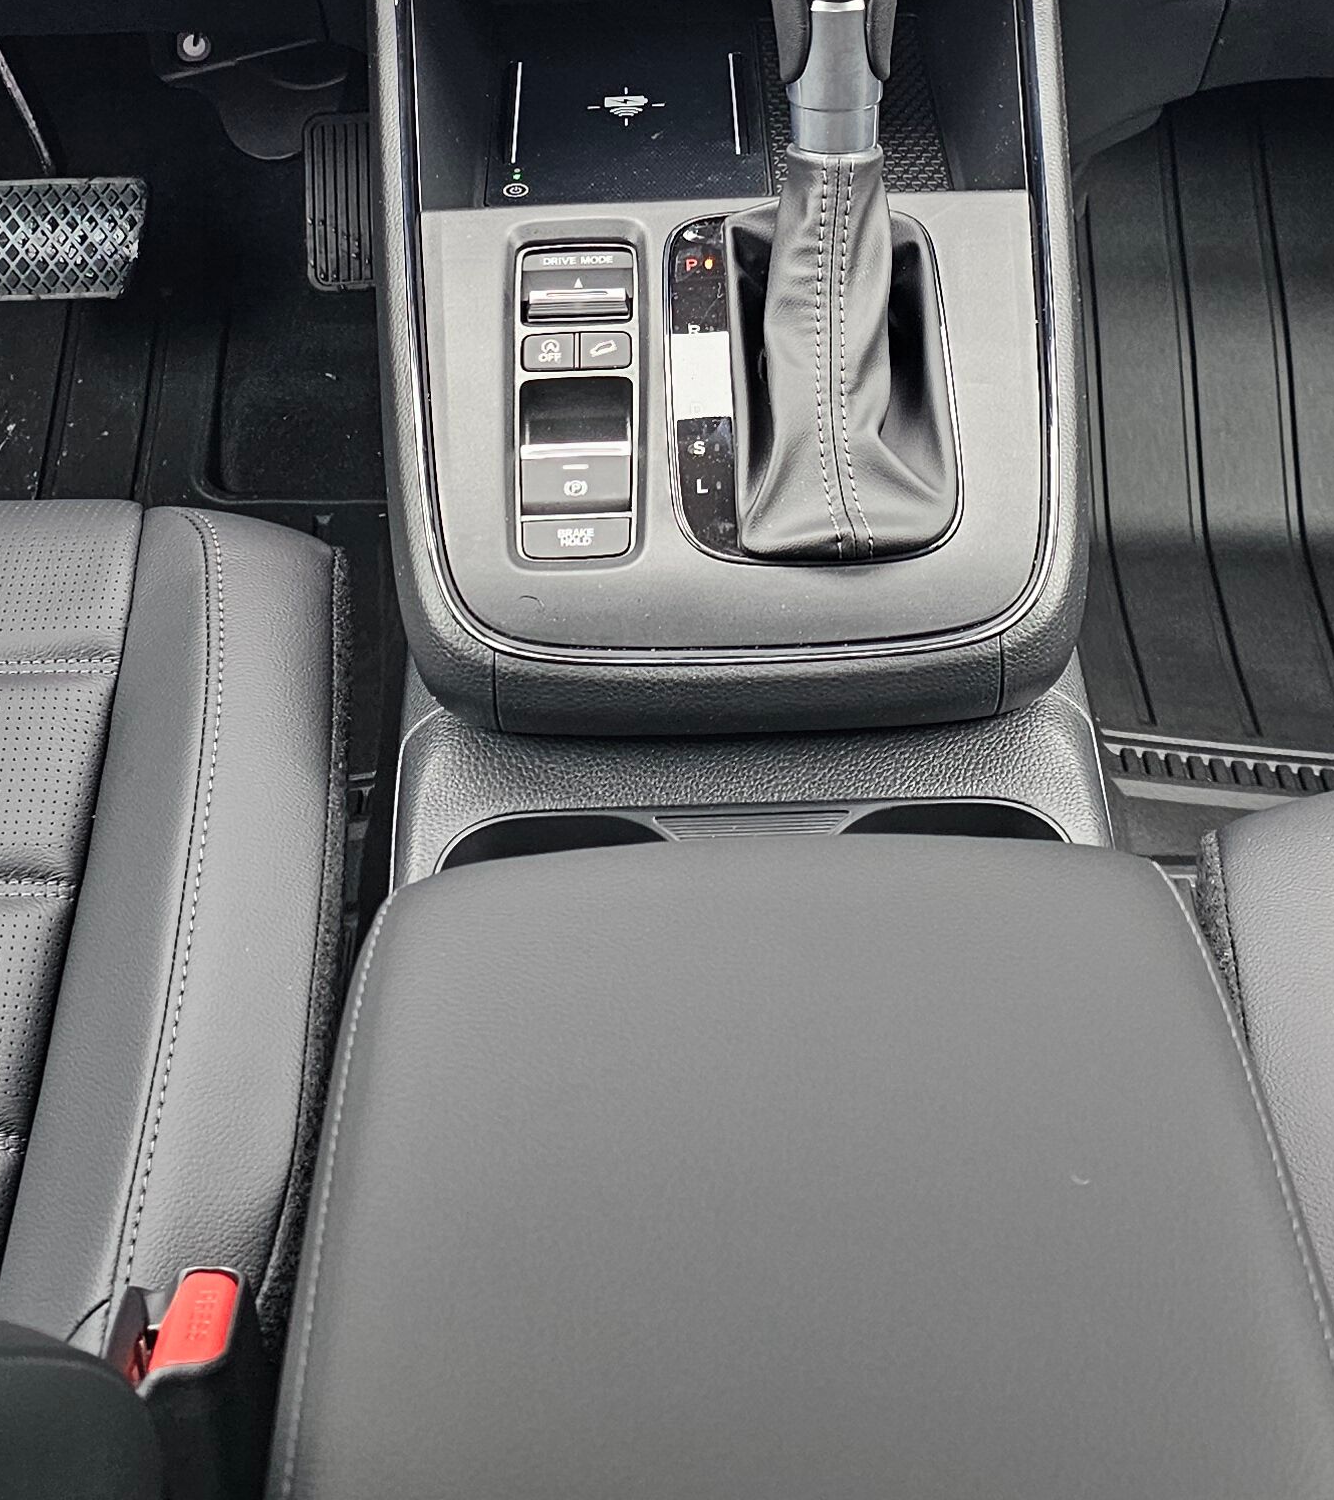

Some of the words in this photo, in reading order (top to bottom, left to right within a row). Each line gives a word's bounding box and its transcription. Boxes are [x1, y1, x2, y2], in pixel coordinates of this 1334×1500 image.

[543, 256, 577, 266] DRIVE
[581, 255, 614, 266] MODE
[685, 258, 698, 271] P
[538, 351, 562, 364] OFF
[693, 440, 706, 455] S
[696, 478, 709, 495] L
[557, 527, 595, 539] BRAKE
[560, 536, 592, 548] HOLD
